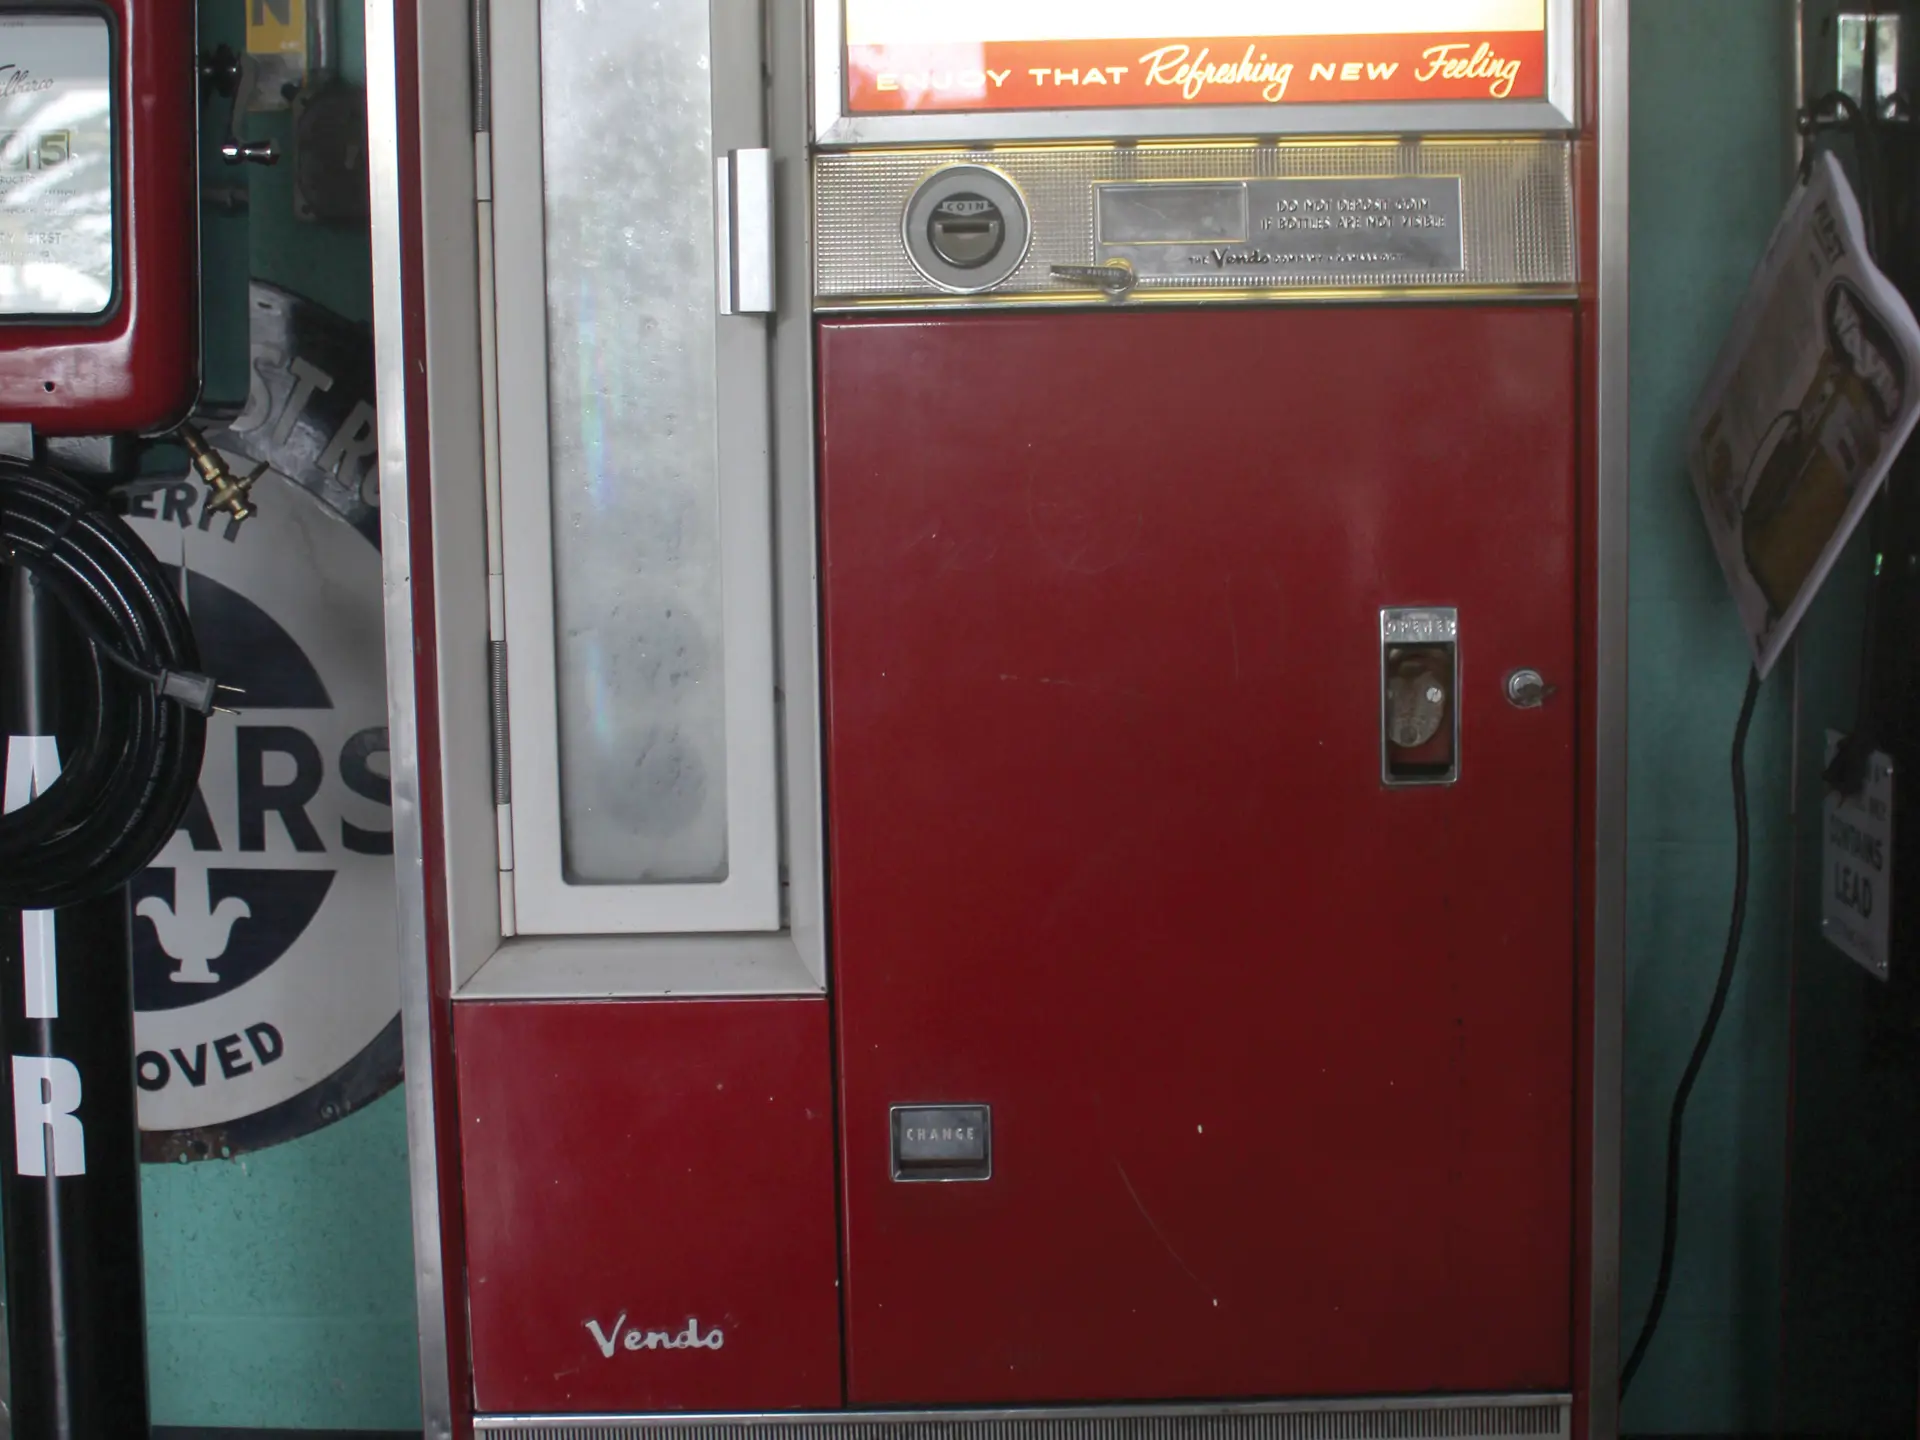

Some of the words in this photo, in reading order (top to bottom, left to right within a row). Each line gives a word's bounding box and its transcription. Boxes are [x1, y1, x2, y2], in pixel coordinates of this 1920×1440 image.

[876, 69, 1011, 91] ENJOY
[1029, 66, 1129, 86] THAT
[1138, 44, 1295, 102] Refreshing
[1310, 62, 1400, 82] NEW
[1414, 42, 1522, 99] Feeling
[946, 201, 986, 212] COIN
[1276, 199, 1300, 212] DO
[1303, 198, 1332, 212] NOT
[1336, 198, 1389, 212] DEPOSIT
[1277, 216, 1332, 230] BOTTLES
[1336, 216, 1362, 229] ARE
[1365, 215, 1393, 228] NOT
[1399, 214, 1447, 228] VISIBLE
[27, 231, 62, 245] FIRST
[1210, 247, 1271, 269] Vendo
[228, 342, 379, 508] STR
[1833, 860, 1873, 920] LEAD
[905, 1126, 976, 1142] CHANGE
[585, 1312, 725, 1359] Vendo
